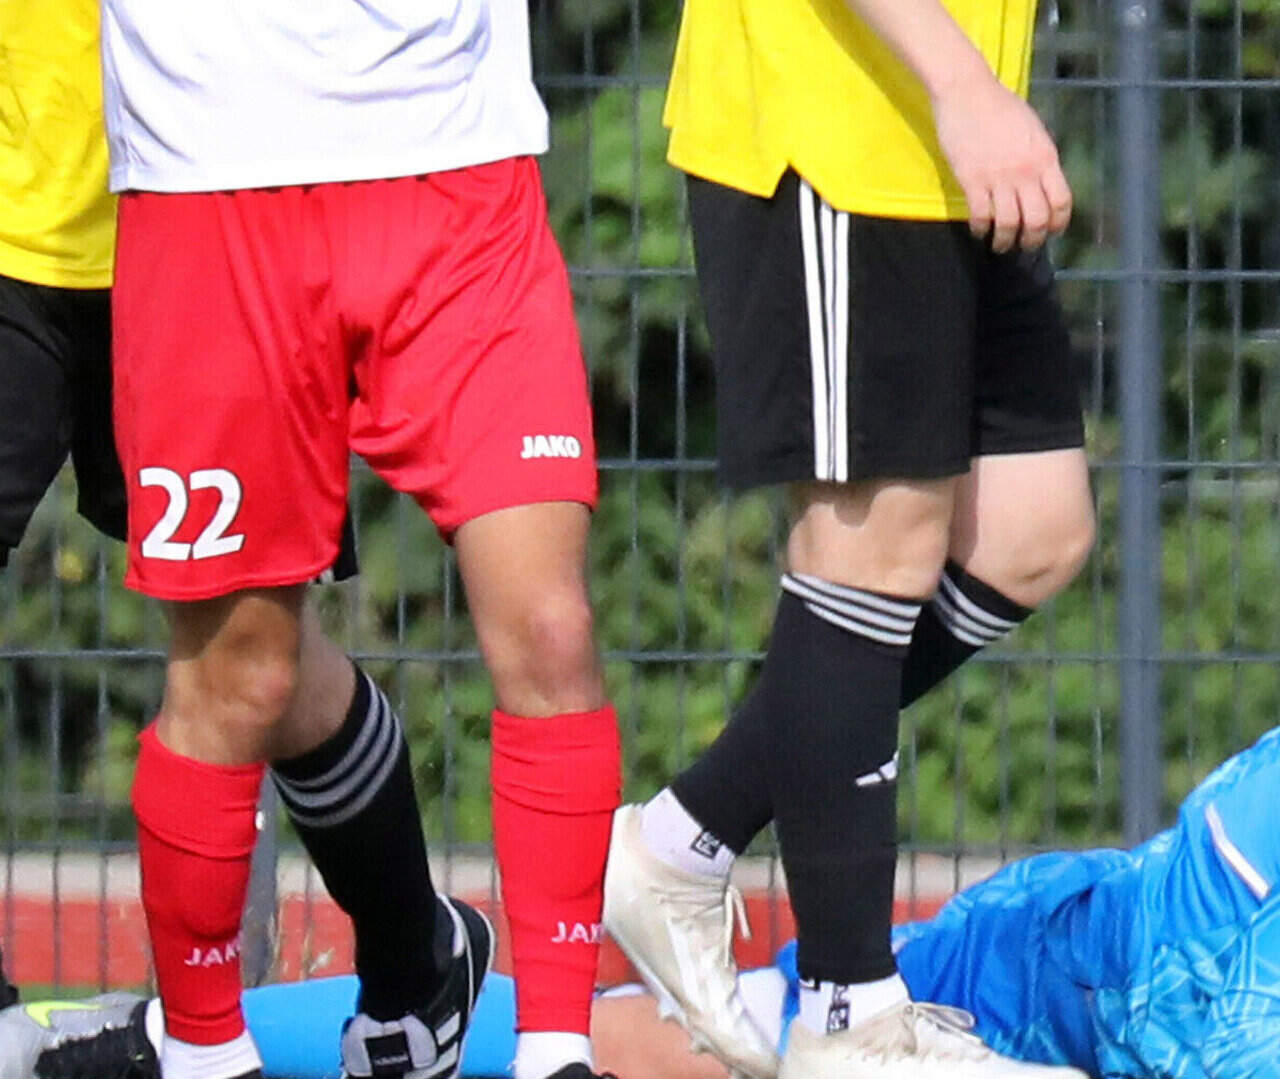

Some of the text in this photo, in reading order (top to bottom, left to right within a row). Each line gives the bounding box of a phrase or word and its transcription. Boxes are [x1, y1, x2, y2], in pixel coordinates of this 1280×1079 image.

[521, 434, 582, 459] JAKO
[139, 467, 244, 561] 22
[183, 930, 244, 968] JAK
